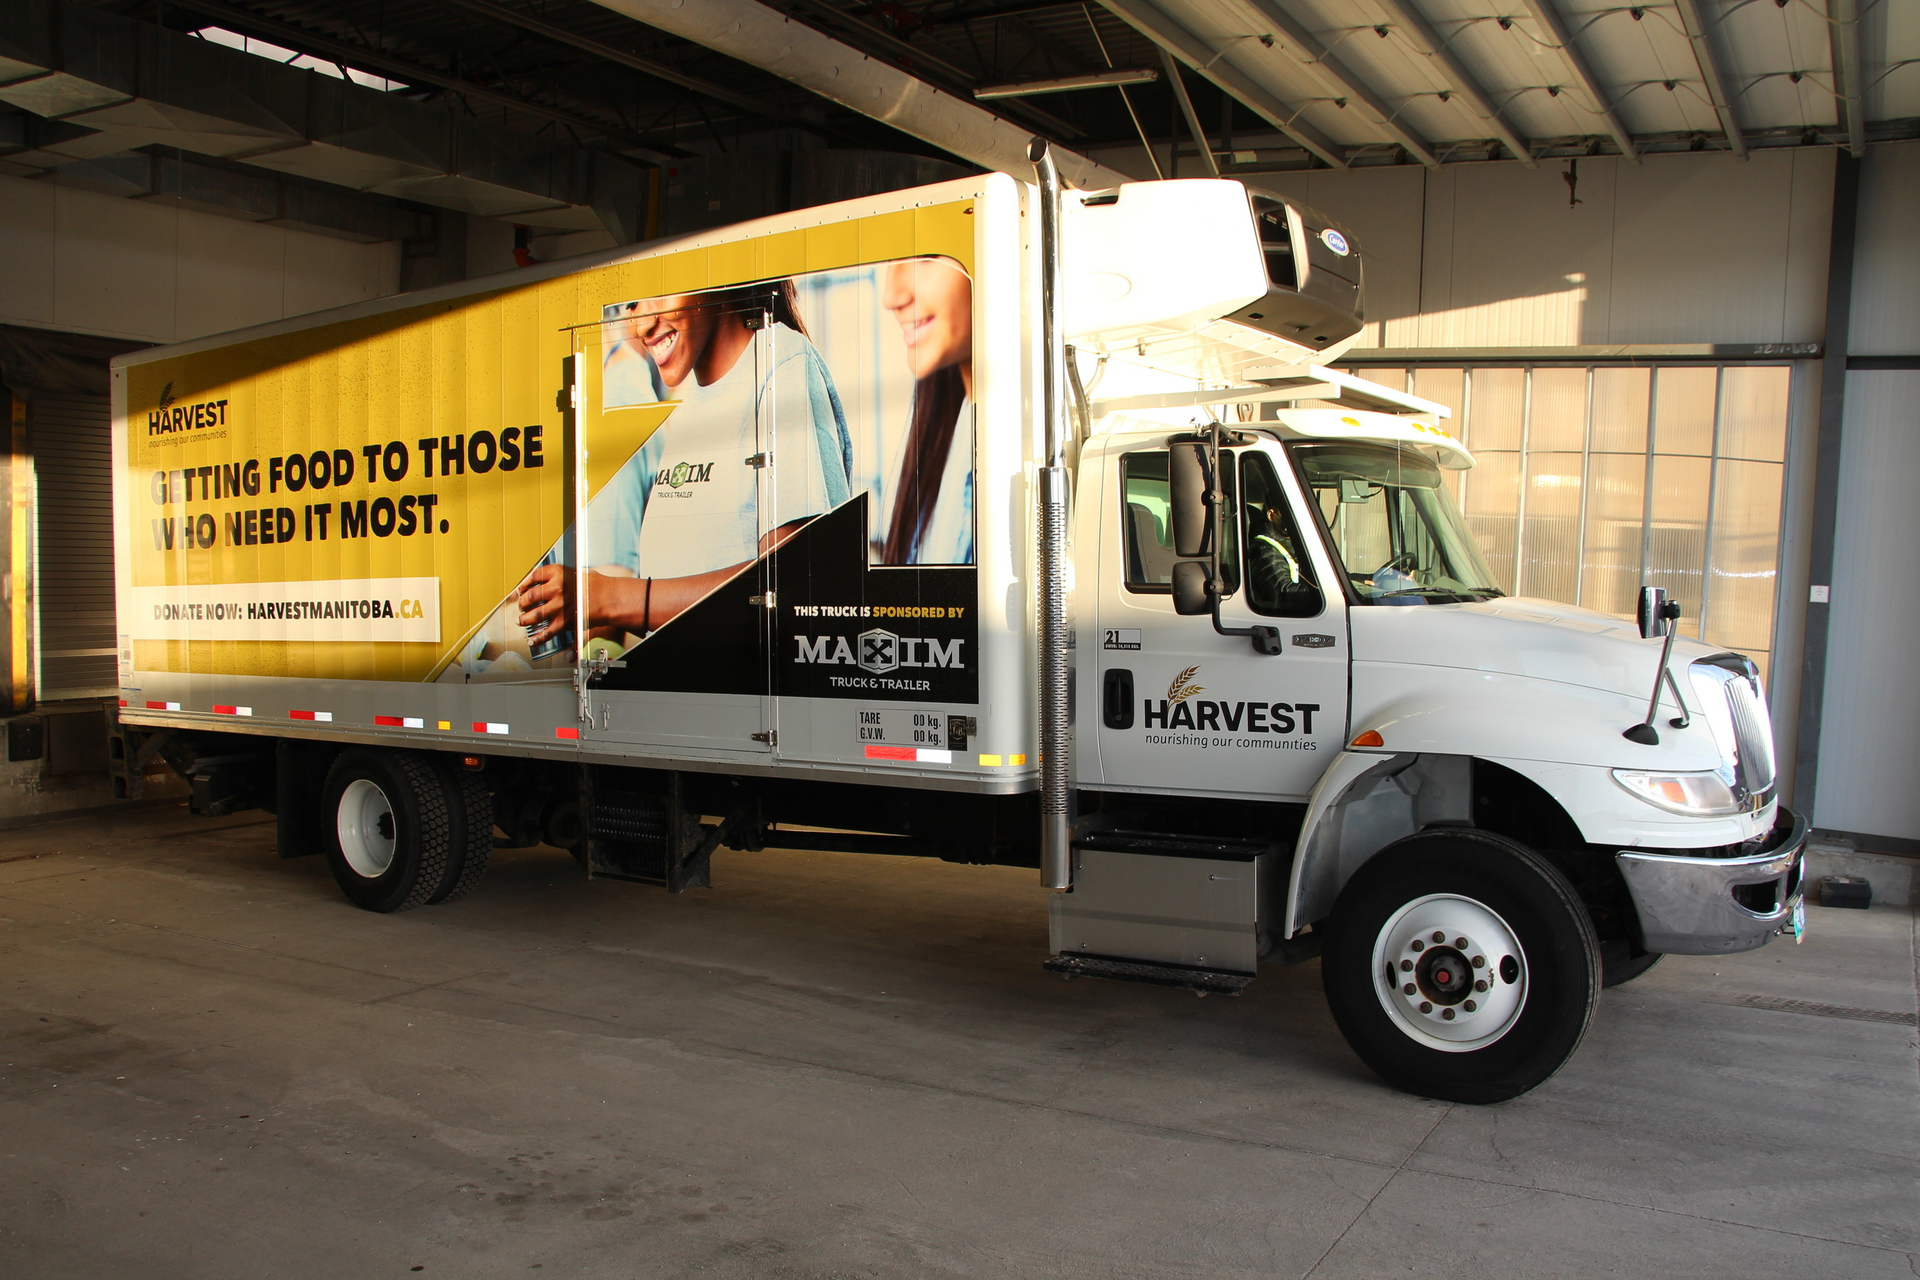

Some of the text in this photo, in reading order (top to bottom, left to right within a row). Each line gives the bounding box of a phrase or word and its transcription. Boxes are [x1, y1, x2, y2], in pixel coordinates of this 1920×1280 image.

[148, 399, 228, 436] HARVEST
[148, 429, 227, 448] nourishing our communities
[151, 425, 544, 506] GETTING FOOD TO THOSE
[674, 491, 693, 499] TRAILER
[151, 494, 450, 551] WHO NEED IT MOST.
[153, 599, 424, 621] DONATE NOW: HARVESTMANITOBA.CA
[794, 606, 965, 618] THIS TRUCK IS SPONSORED BY
[1106, 630, 1119, 643] 21
[794, 627, 965, 675] MAXIM
[829, 676, 931, 691] TRUCK & TRAILER
[859, 711, 941, 730] TARE 00 kg.
[1144, 699, 1321, 735] HARVEST
[860, 727, 886, 741] G.V.W.
[913, 730, 925, 743] 00
[928, 730, 941, 746] kg.
[1145, 733, 1317, 751] nourishing our communities
